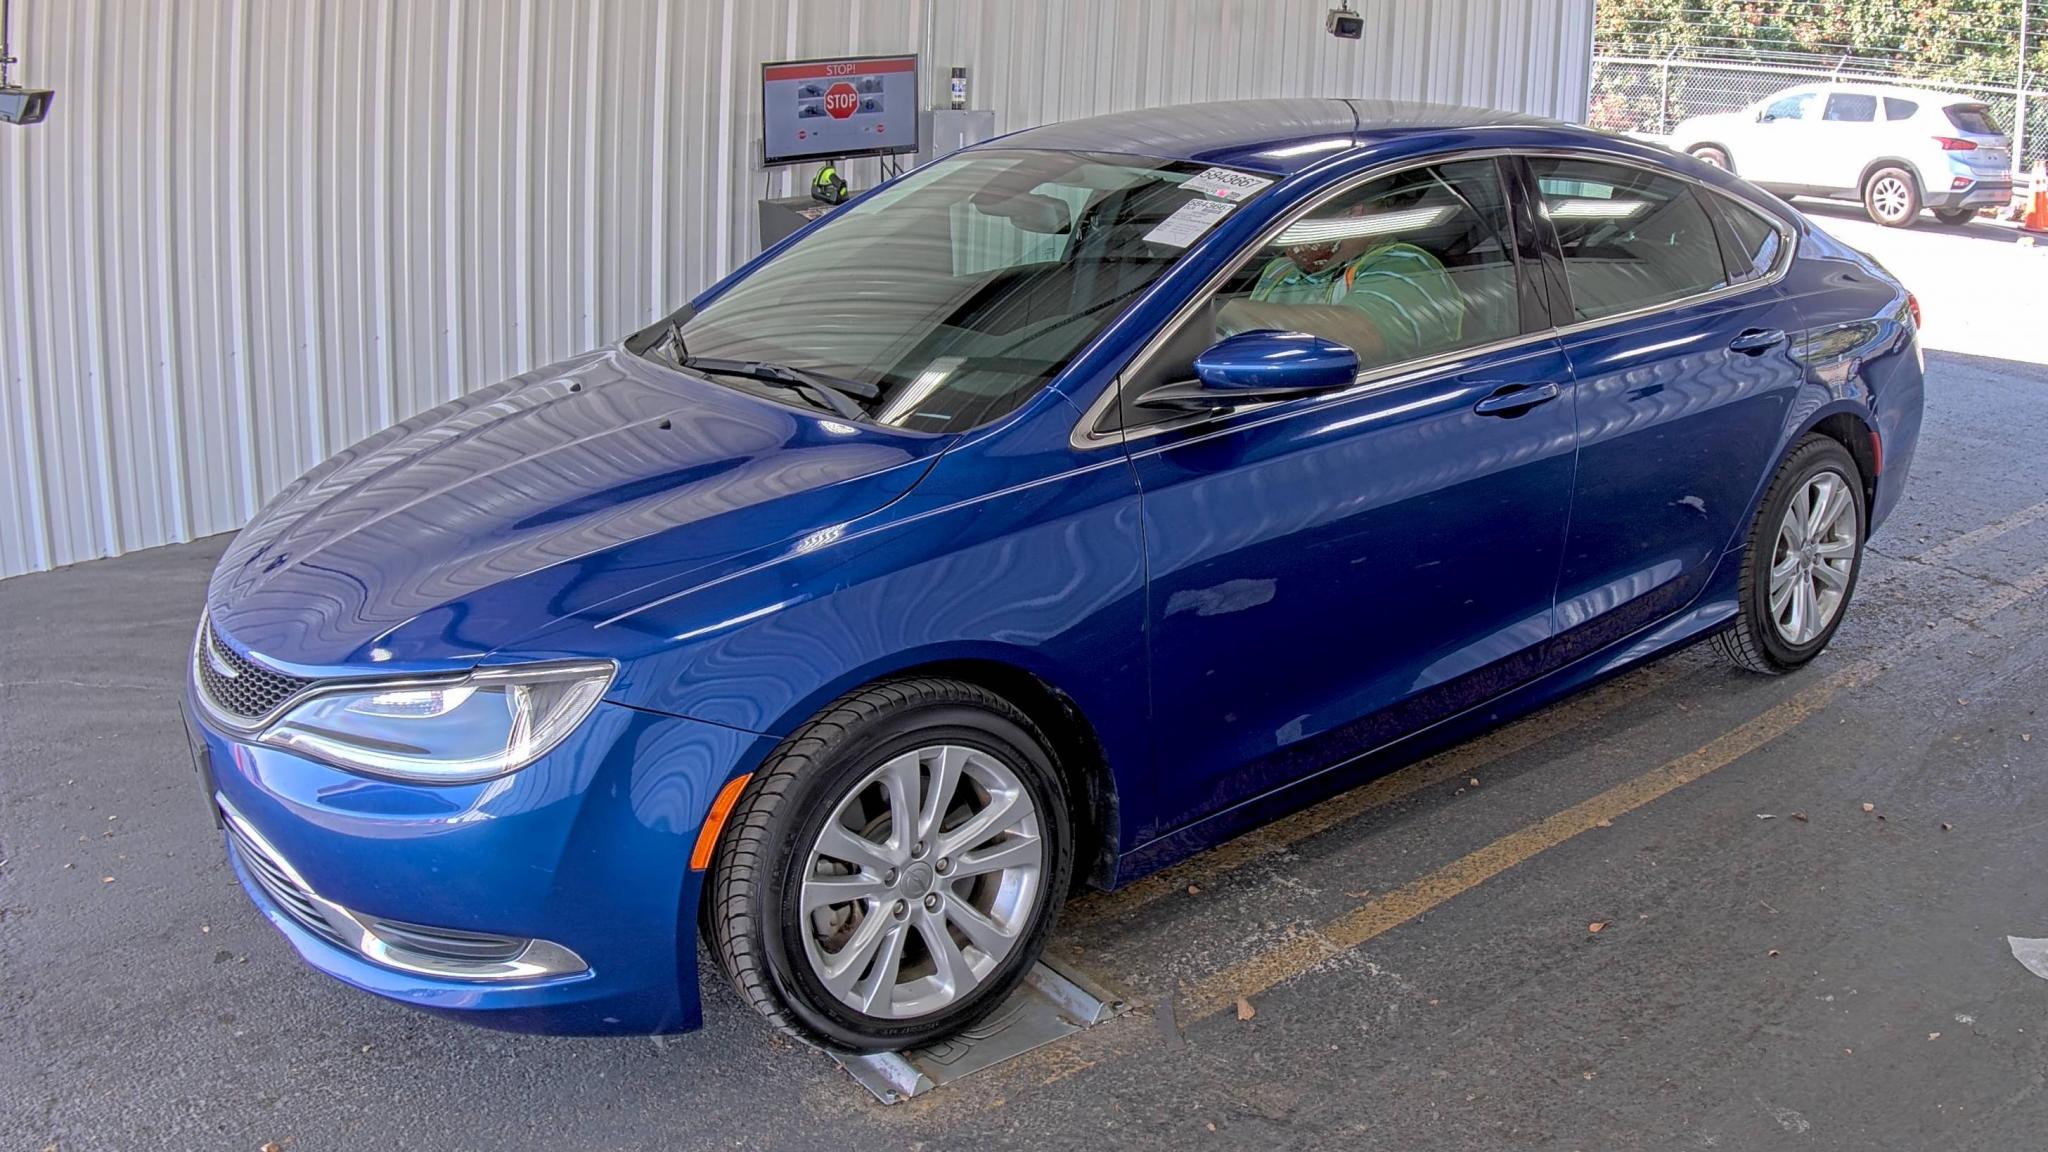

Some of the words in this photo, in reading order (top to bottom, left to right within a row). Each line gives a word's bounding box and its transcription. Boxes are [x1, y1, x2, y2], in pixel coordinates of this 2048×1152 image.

[826, 63, 856, 76] STOP!
[827, 93, 857, 109] STOP
[1200, 169, 1264, 188] 5843667
